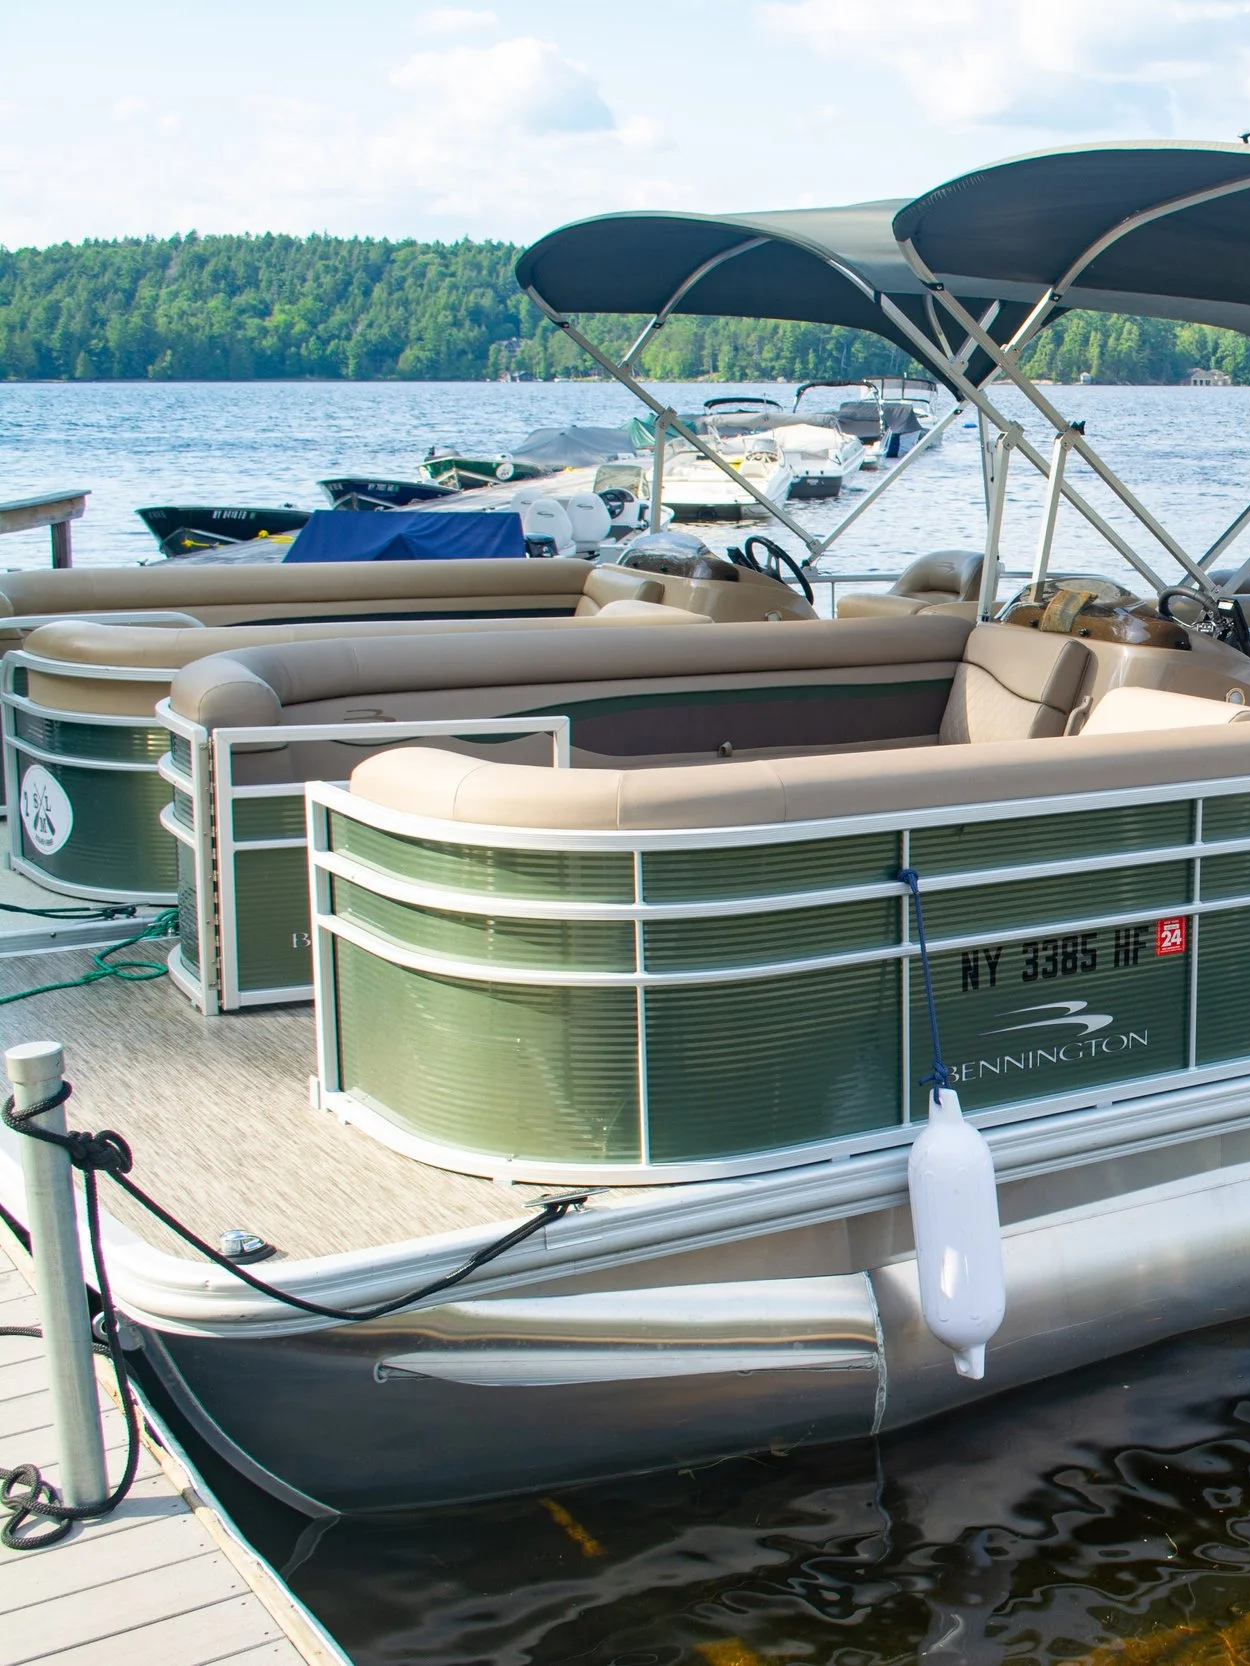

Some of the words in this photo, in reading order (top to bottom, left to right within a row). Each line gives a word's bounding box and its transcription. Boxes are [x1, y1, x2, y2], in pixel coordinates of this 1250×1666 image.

[961, 946, 1004, 993] NY
[1022, 932, 1098, 983] 3385
[1114, 926, 1150, 968] HF
[1161, 929, 1182, 948] 24
